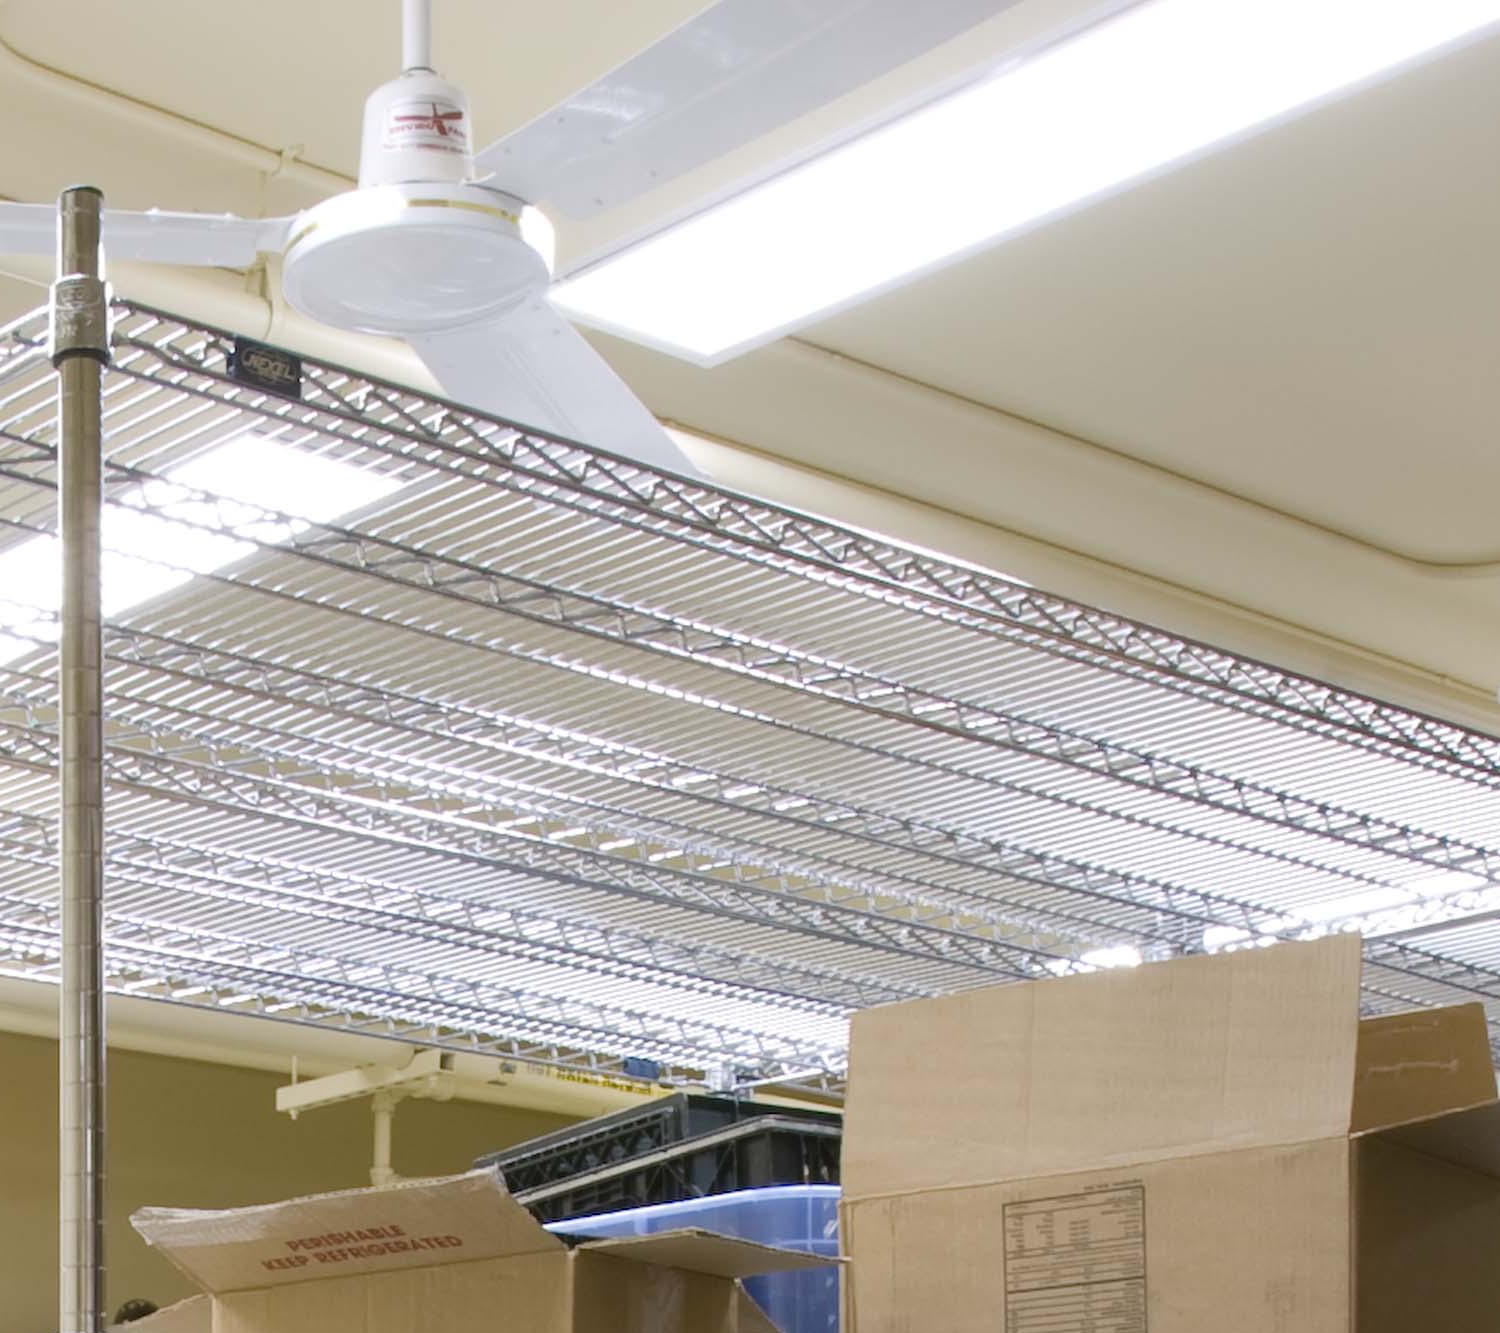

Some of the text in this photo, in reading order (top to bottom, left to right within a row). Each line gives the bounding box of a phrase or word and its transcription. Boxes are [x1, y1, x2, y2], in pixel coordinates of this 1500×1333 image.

[261, 1235, 463, 1272] KEEP REFRIGERATED
[285, 1224, 407, 1252] PERISHABLE
